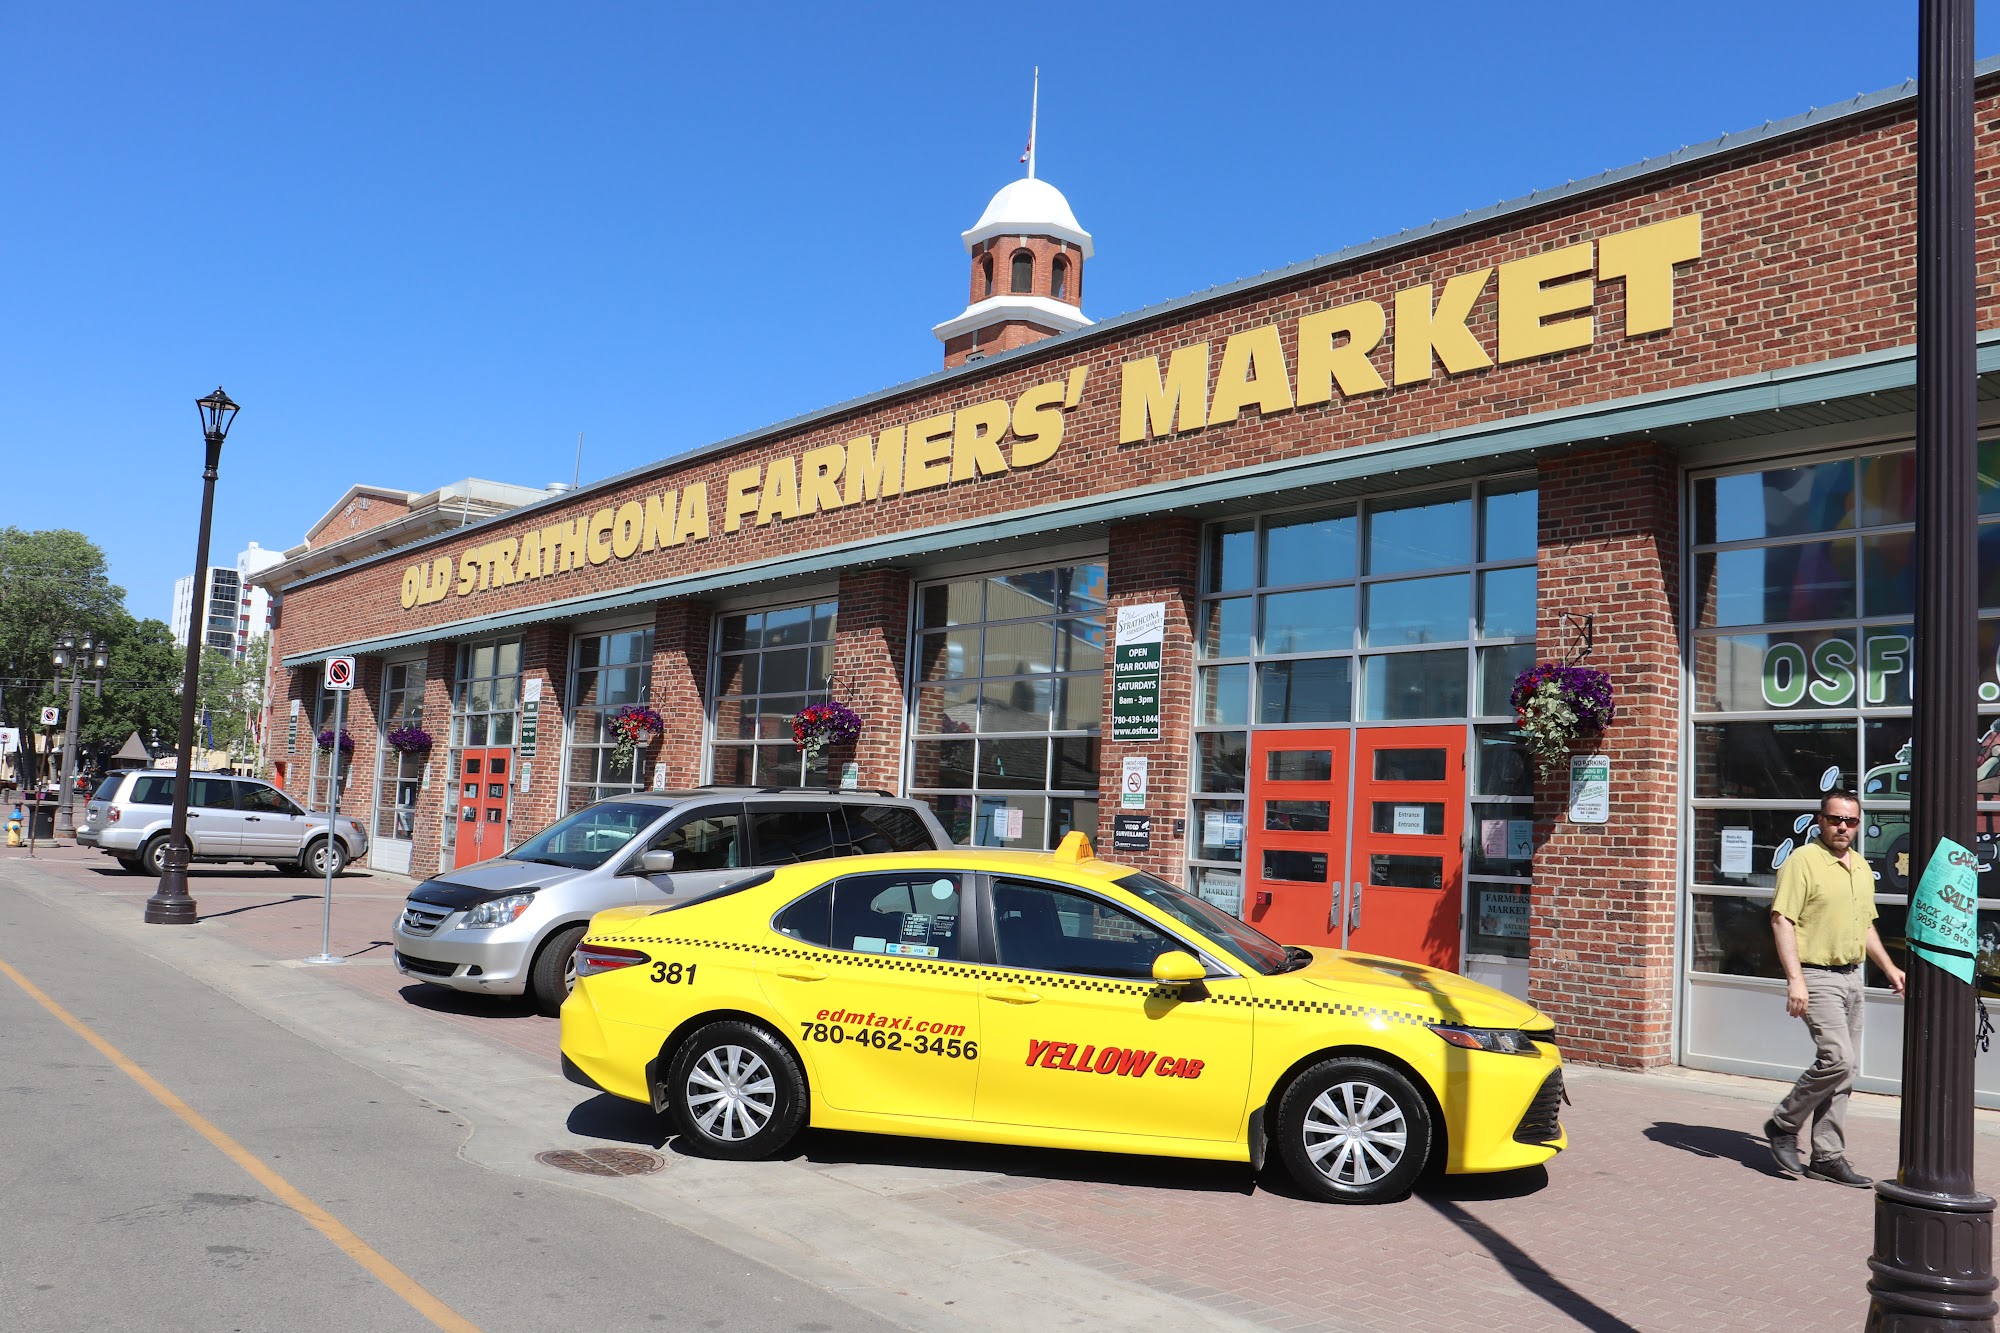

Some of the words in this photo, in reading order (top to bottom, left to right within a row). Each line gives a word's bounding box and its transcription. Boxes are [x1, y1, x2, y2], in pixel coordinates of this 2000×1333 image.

[402, 555, 452, 609] OLD
[457, 481, 710, 596] STRATHCONA
[723, 365, 1089, 533] FARMERS'
[1119, 213, 1702, 445] MARKET
[1117, 611, 1160, 633] STRATHCONA
[1128, 648, 1148, 657] OPEN
[1116, 663, 1133, 672] YEAR
[1134, 661, 1160, 670] ROUND
[1761, 634, 2000, 707] OSF.
[1117, 681, 1156, 691] SATURDAYS
[1119, 696, 1133, 704] 8am
[1138, 695, 1154, 706] 3pm
[1114, 715, 1158, 724] 780-439-1844
[1114, 727, 1158, 735] www.osfm.ca
[1115, 830, 1148, 838] SURVEILLANCE
[1947, 851, 1978, 873] GARA
[1203, 878, 1235, 887] FARMERS
[1205, 888, 1234, 896] MARKET
[1486, 894, 1530, 904] FARMERS
[1937, 885, 1974, 915] SALE
[1488, 905, 1527, 914] MARKET
[1916, 899, 1941, 918] BACK
[1917, 912, 1938, 929] 9855
[1939, 924, 1952, 936] 83
[650, 961, 697, 985] 381
[816, 1008, 966, 1037] edmtaxi.com
[800, 1021, 978, 1060] 780-462-3456
[1025, 1039, 1157, 1078] YELLOW
[1153, 1056, 1205, 1079] CAB
